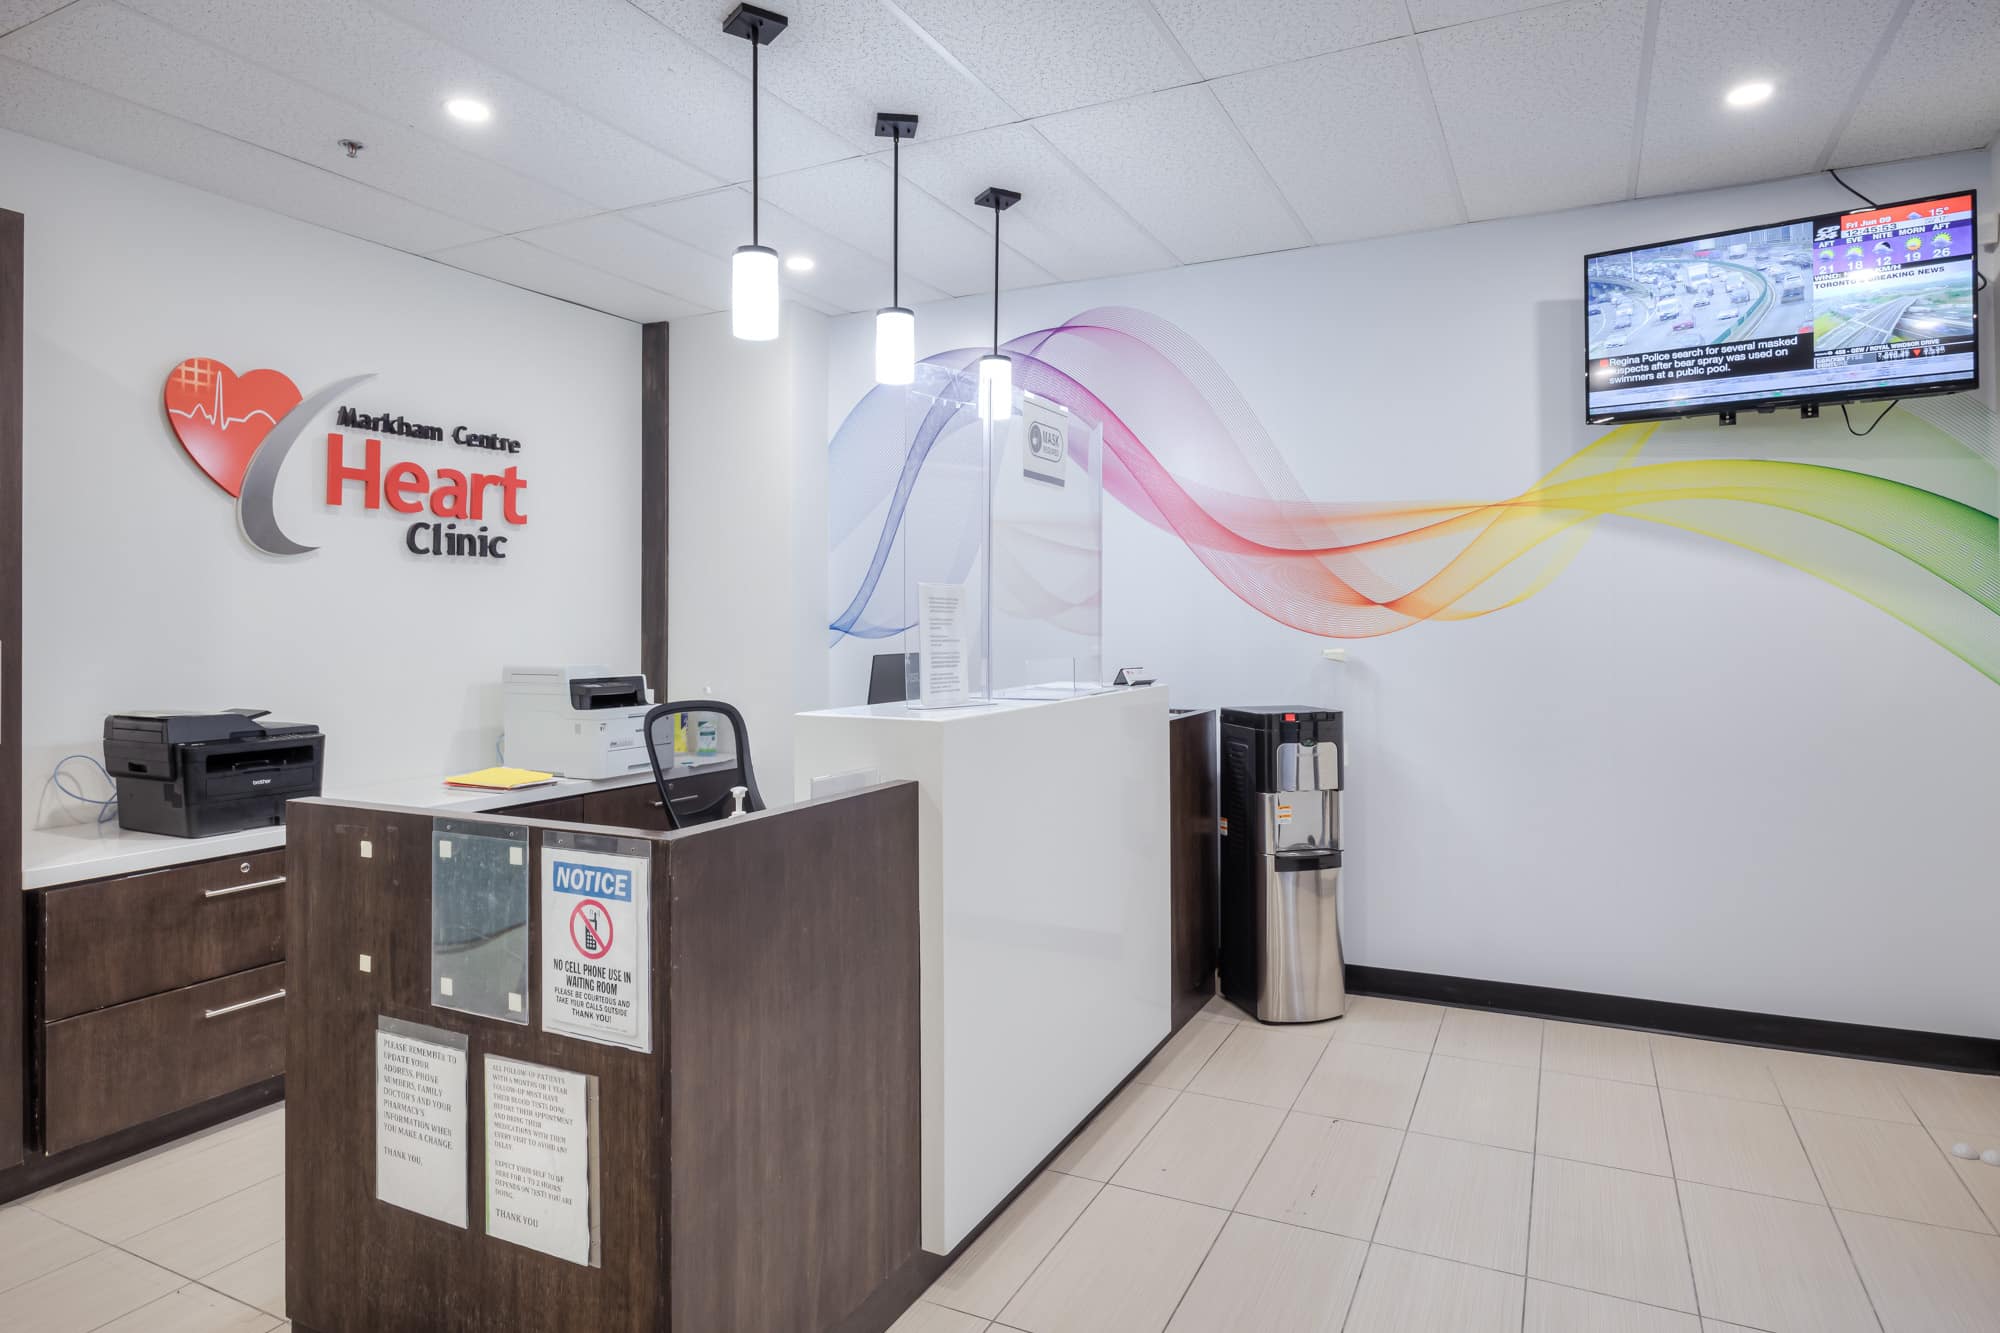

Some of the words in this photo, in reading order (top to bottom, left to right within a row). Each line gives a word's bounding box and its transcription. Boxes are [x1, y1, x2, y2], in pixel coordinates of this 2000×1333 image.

[1846, 218, 1858, 228] Fri
[1860, 218, 1876, 227] Jun
[1846, 236, 1862, 244] EVE
[1899, 227, 1925, 236] MORN
[1819, 265, 1834, 274] 21
[1848, 261, 1863, 270] 18
[1876, 256, 1892, 266] 12
[1905, 252, 1921, 262] 19
[1934, 248, 1950, 258] 26
[1918, 266, 1944, 275] NEWS
[1609, 356, 1640, 368] Regina
[1642, 352, 1670, 363] Police
[1672, 348, 1704, 360] search
[1706, 345, 1718, 354] for
[1721, 341, 1756, 352] several
[1758, 336, 1798, 349] masked
[1611, 364, 1649, 376] uspects
[1651, 360, 1672, 371] after
[1674, 358, 1694, 368] bear
[1698, 355, 1724, 367] spray
[1726, 353, 1746, 362] was
[1748, 349, 1773, 360] used
[1775, 348, 1788, 356] on
[1609, 372, 1655, 385] swimmers
[1657, 371, 1666, 379] at
[1676, 366, 1704, 380] public
[1707, 363, 1731, 375] pool.
[336, 406, 443, 442] Markham
[451, 426, 522, 454] Centre
[326, 433, 528, 525] Heart
[406, 522, 508, 558] Clinic
[556, 866, 628, 897] NOTICE
[553, 958, 563, 971] NO
[564, 960, 582, 974] CELL
[584, 964, 606, 980] PHONE
[608, 968, 622, 982] USE
[624, 970, 632, 984] IN
[566, 975, 594, 992] WAITING
[596, 980, 618, 996] ROOM
[554, 986, 574, 997] PLEASE
[575, 991, 582, 999] BE
[584, 993, 616, 1006] COURTEOUS
[618, 1000, 630, 1008] AND
[556, 996, 568, 1004] TAKE
[570, 998, 584, 1008] YOUR
[586, 1002, 602, 1012] CALLS
[604, 1006, 628, 1016] OUTSIDE
[572, 1008, 594, 1019] THANK
[596, 1014, 612, 1024] YOU!
[384, 1040, 406, 1052] PLEASE
[448, 1054, 457, 1064] TO
[384, 1051, 409, 1064] UPDATE
[411, 1058, 429, 1070] YOUR
[416, 1070, 438, 1084] PHONE
[492, 1074, 508, 1082] WITH
[553, 1086, 568, 1096] YEAR
[418, 1084, 442, 1097] FAMILY
[494, 1093, 510, 1102] THEIR
[542, 1094, 558, 1102] HAVE
[416, 1095, 431, 1106] AND
[432, 1099, 452, 1113] YOUR
[516, 1107, 532, 1116] THEIR
[384, 1111, 430, 1131] INFORMATION
[432, 1123, 452, 1137] WHEN
[494, 1112, 506, 1120] AND
[525, 1119, 542, 1128] THEIR
[384, 1122, 397, 1133] YOU
[398, 1126, 418, 1139] MAKE
[494, 1131, 511, 1140] EVERY
[512, 1136, 526, 1144] VISIT
[528, 1138, 536, 1146] TO
[533, 1131, 548, 1140] WITH
[384, 1146, 406, 1161] THANK
[510, 1173, 522, 1182] FOR
[541, 1181, 561, 1192] HOURS
[496, 1208, 522, 1223] THANK
